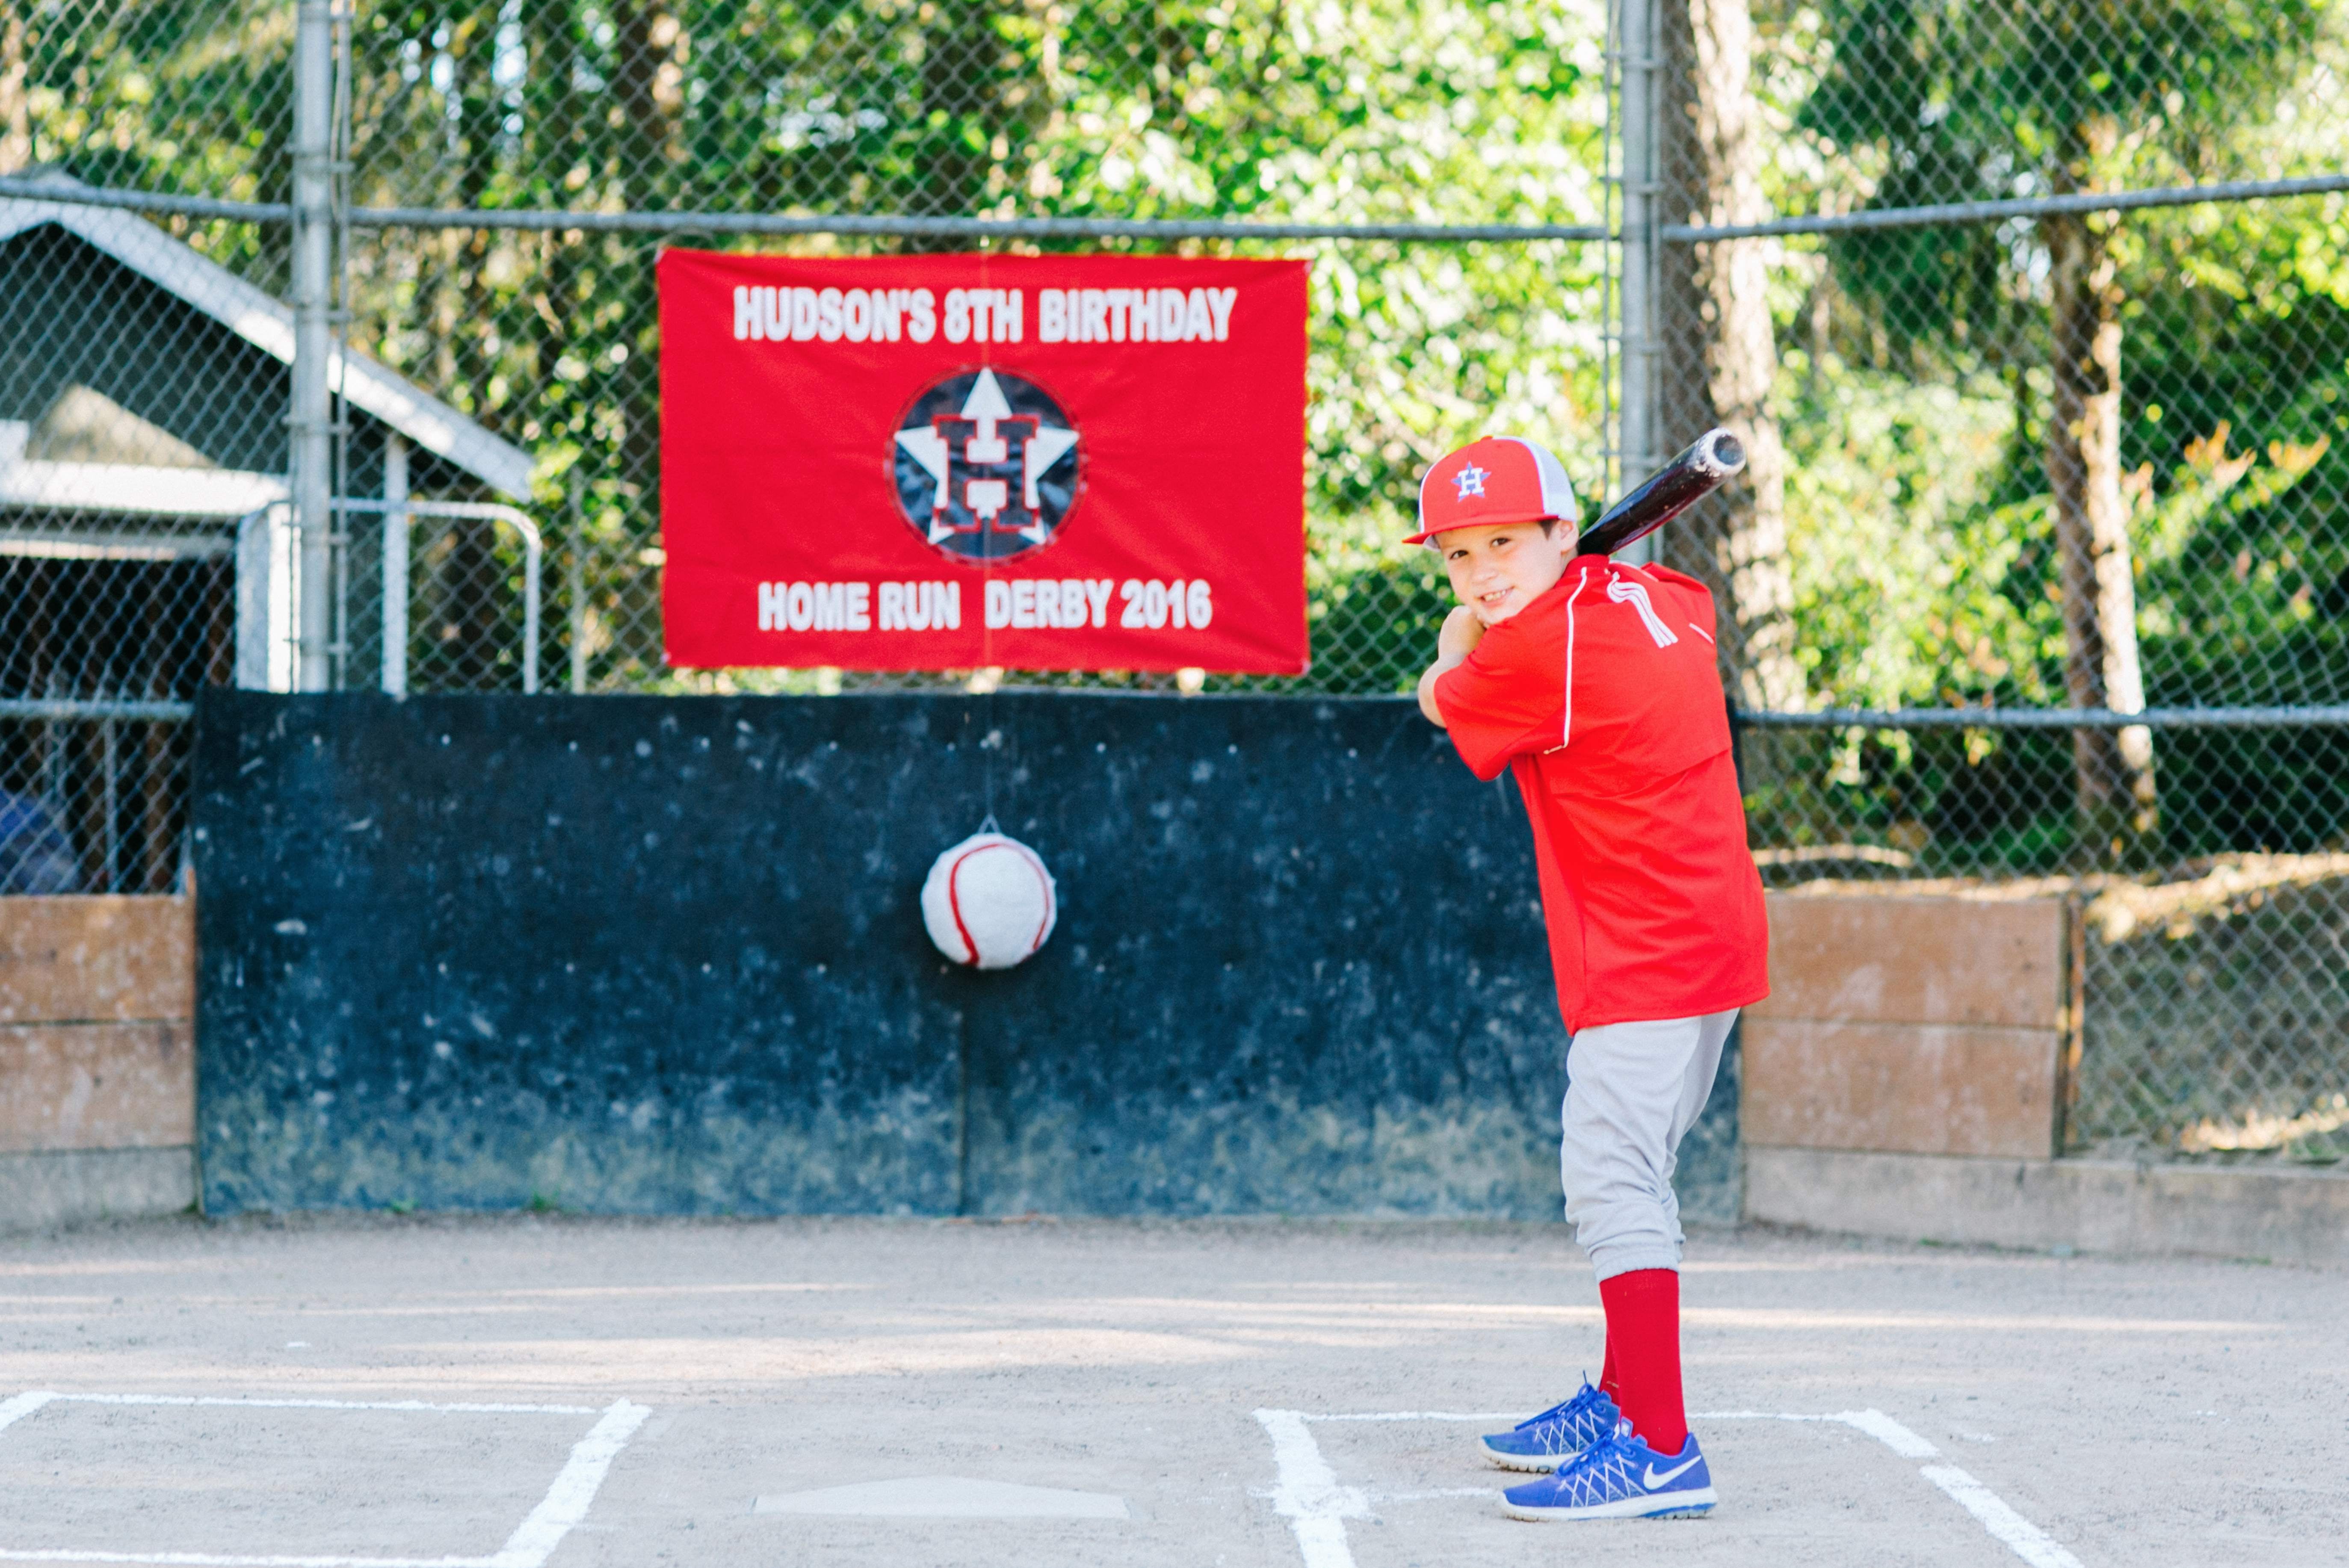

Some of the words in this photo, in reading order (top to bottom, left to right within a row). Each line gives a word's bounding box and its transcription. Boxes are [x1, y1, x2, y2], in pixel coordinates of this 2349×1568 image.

[733, 285, 937, 343] HUDSON'S
[944, 288, 1023, 343] 8TH
[1039, 287, 1237, 343] BIRTHDAY
[931, 413, 1041, 533] H
[1458, 467, 1484, 496] H
[758, 582, 871, 632] HOME
[878, 581, 961, 631] RUN
[984, 579, 1114, 629] DERBY
[1120, 579, 1213, 629] 2016
